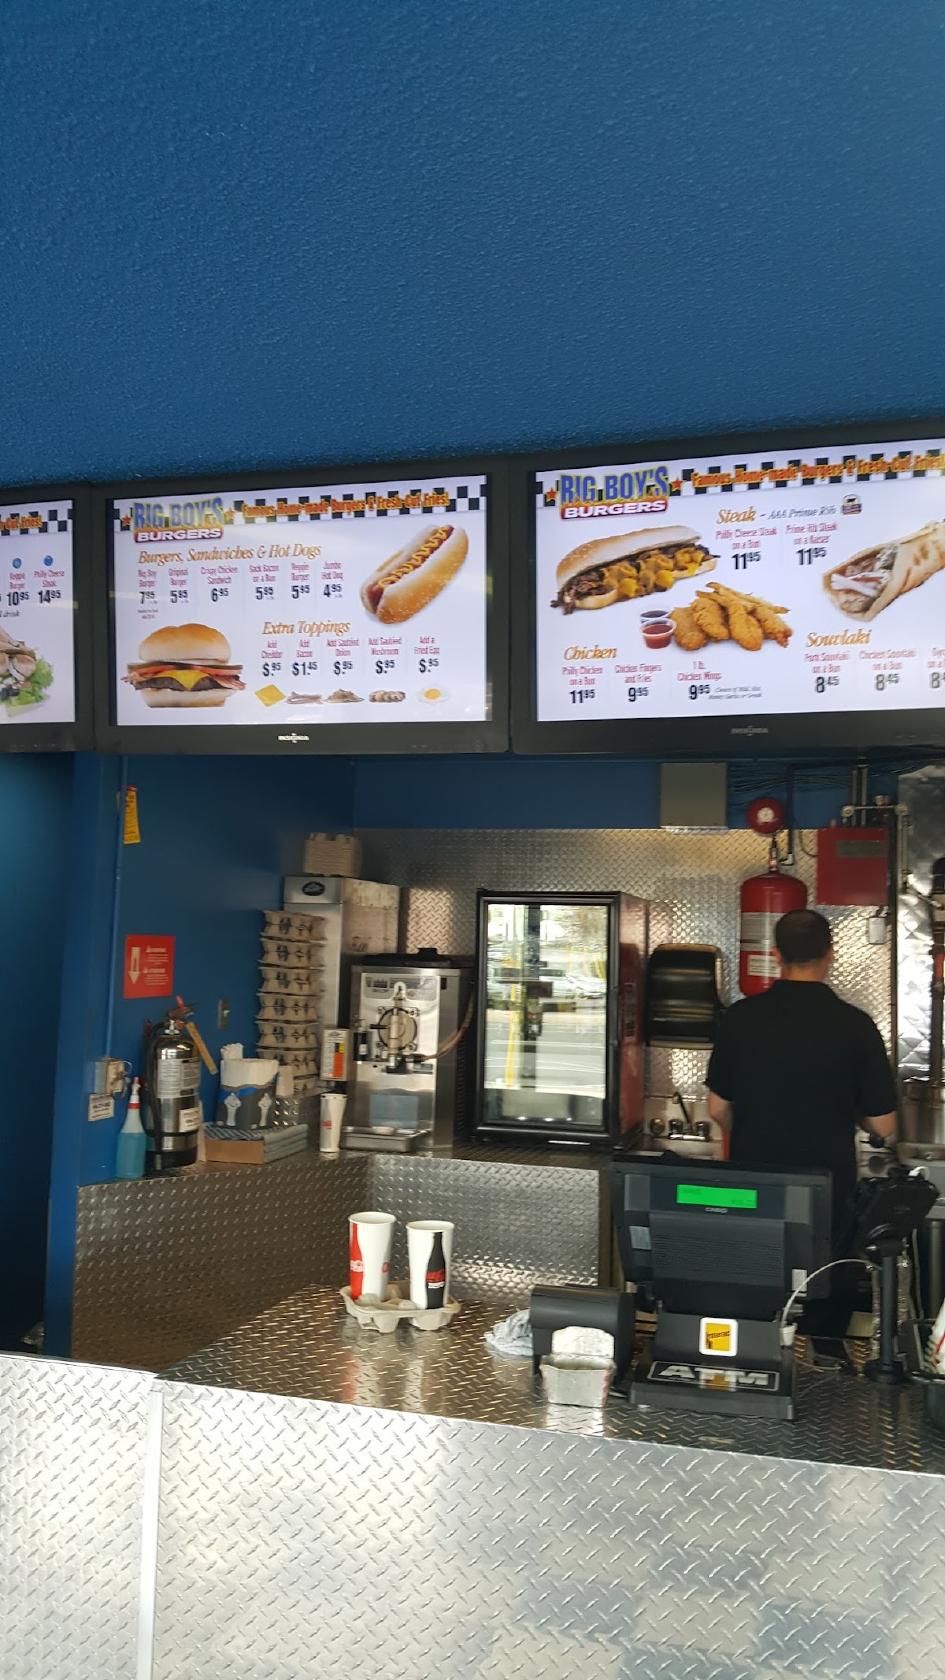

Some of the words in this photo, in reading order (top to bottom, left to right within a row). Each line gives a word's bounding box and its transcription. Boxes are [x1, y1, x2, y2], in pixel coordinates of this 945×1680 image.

[605, 466, 669, 501] BOY'S
[170, 496, 224, 528] BOY'S
[564, 500, 667, 518] BURGERS
[717, 506, 757, 524] Steak
[137, 528, 222, 542] BURGERS
[187, 545, 254, 562] Sandwiches
[257, 545, 267, 559] &
[268, 543, 290, 558] Hot
[292, 543, 322, 560] Dogs
[218, 565, 239, 574] Chicken
[262, 621, 295, 635] Extra
[297, 620, 351, 637] Toppings
[806, 628, 872, 648] Souvlaki
[563, 644, 618, 661] Chicken
